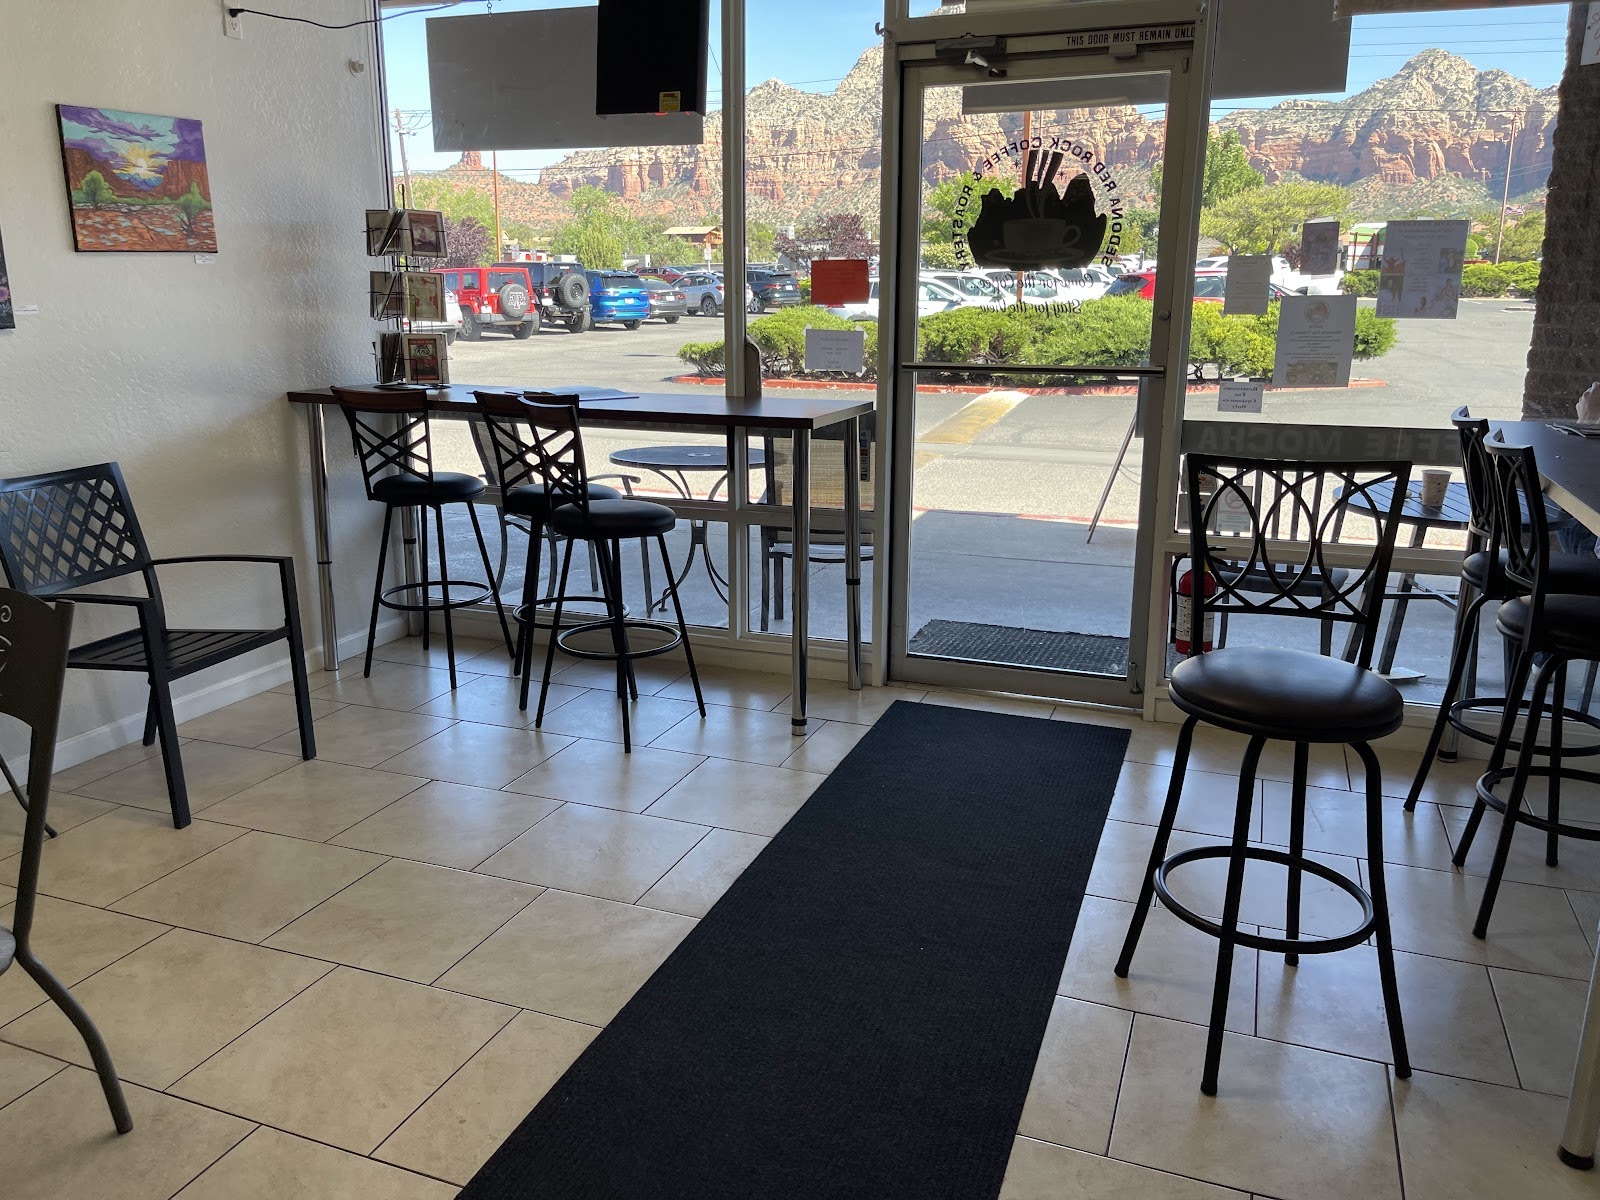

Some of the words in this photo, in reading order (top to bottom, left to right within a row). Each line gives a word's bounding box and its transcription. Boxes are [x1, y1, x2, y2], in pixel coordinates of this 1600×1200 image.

[1066, 35, 1084, 46] THIS
[1087, 33, 1109, 45] DOOR
[1112, 31, 1136, 43] MUST
[1139, 29, 1171, 41] REMAIN
[1174, 27, 1195, 39] UNLO
